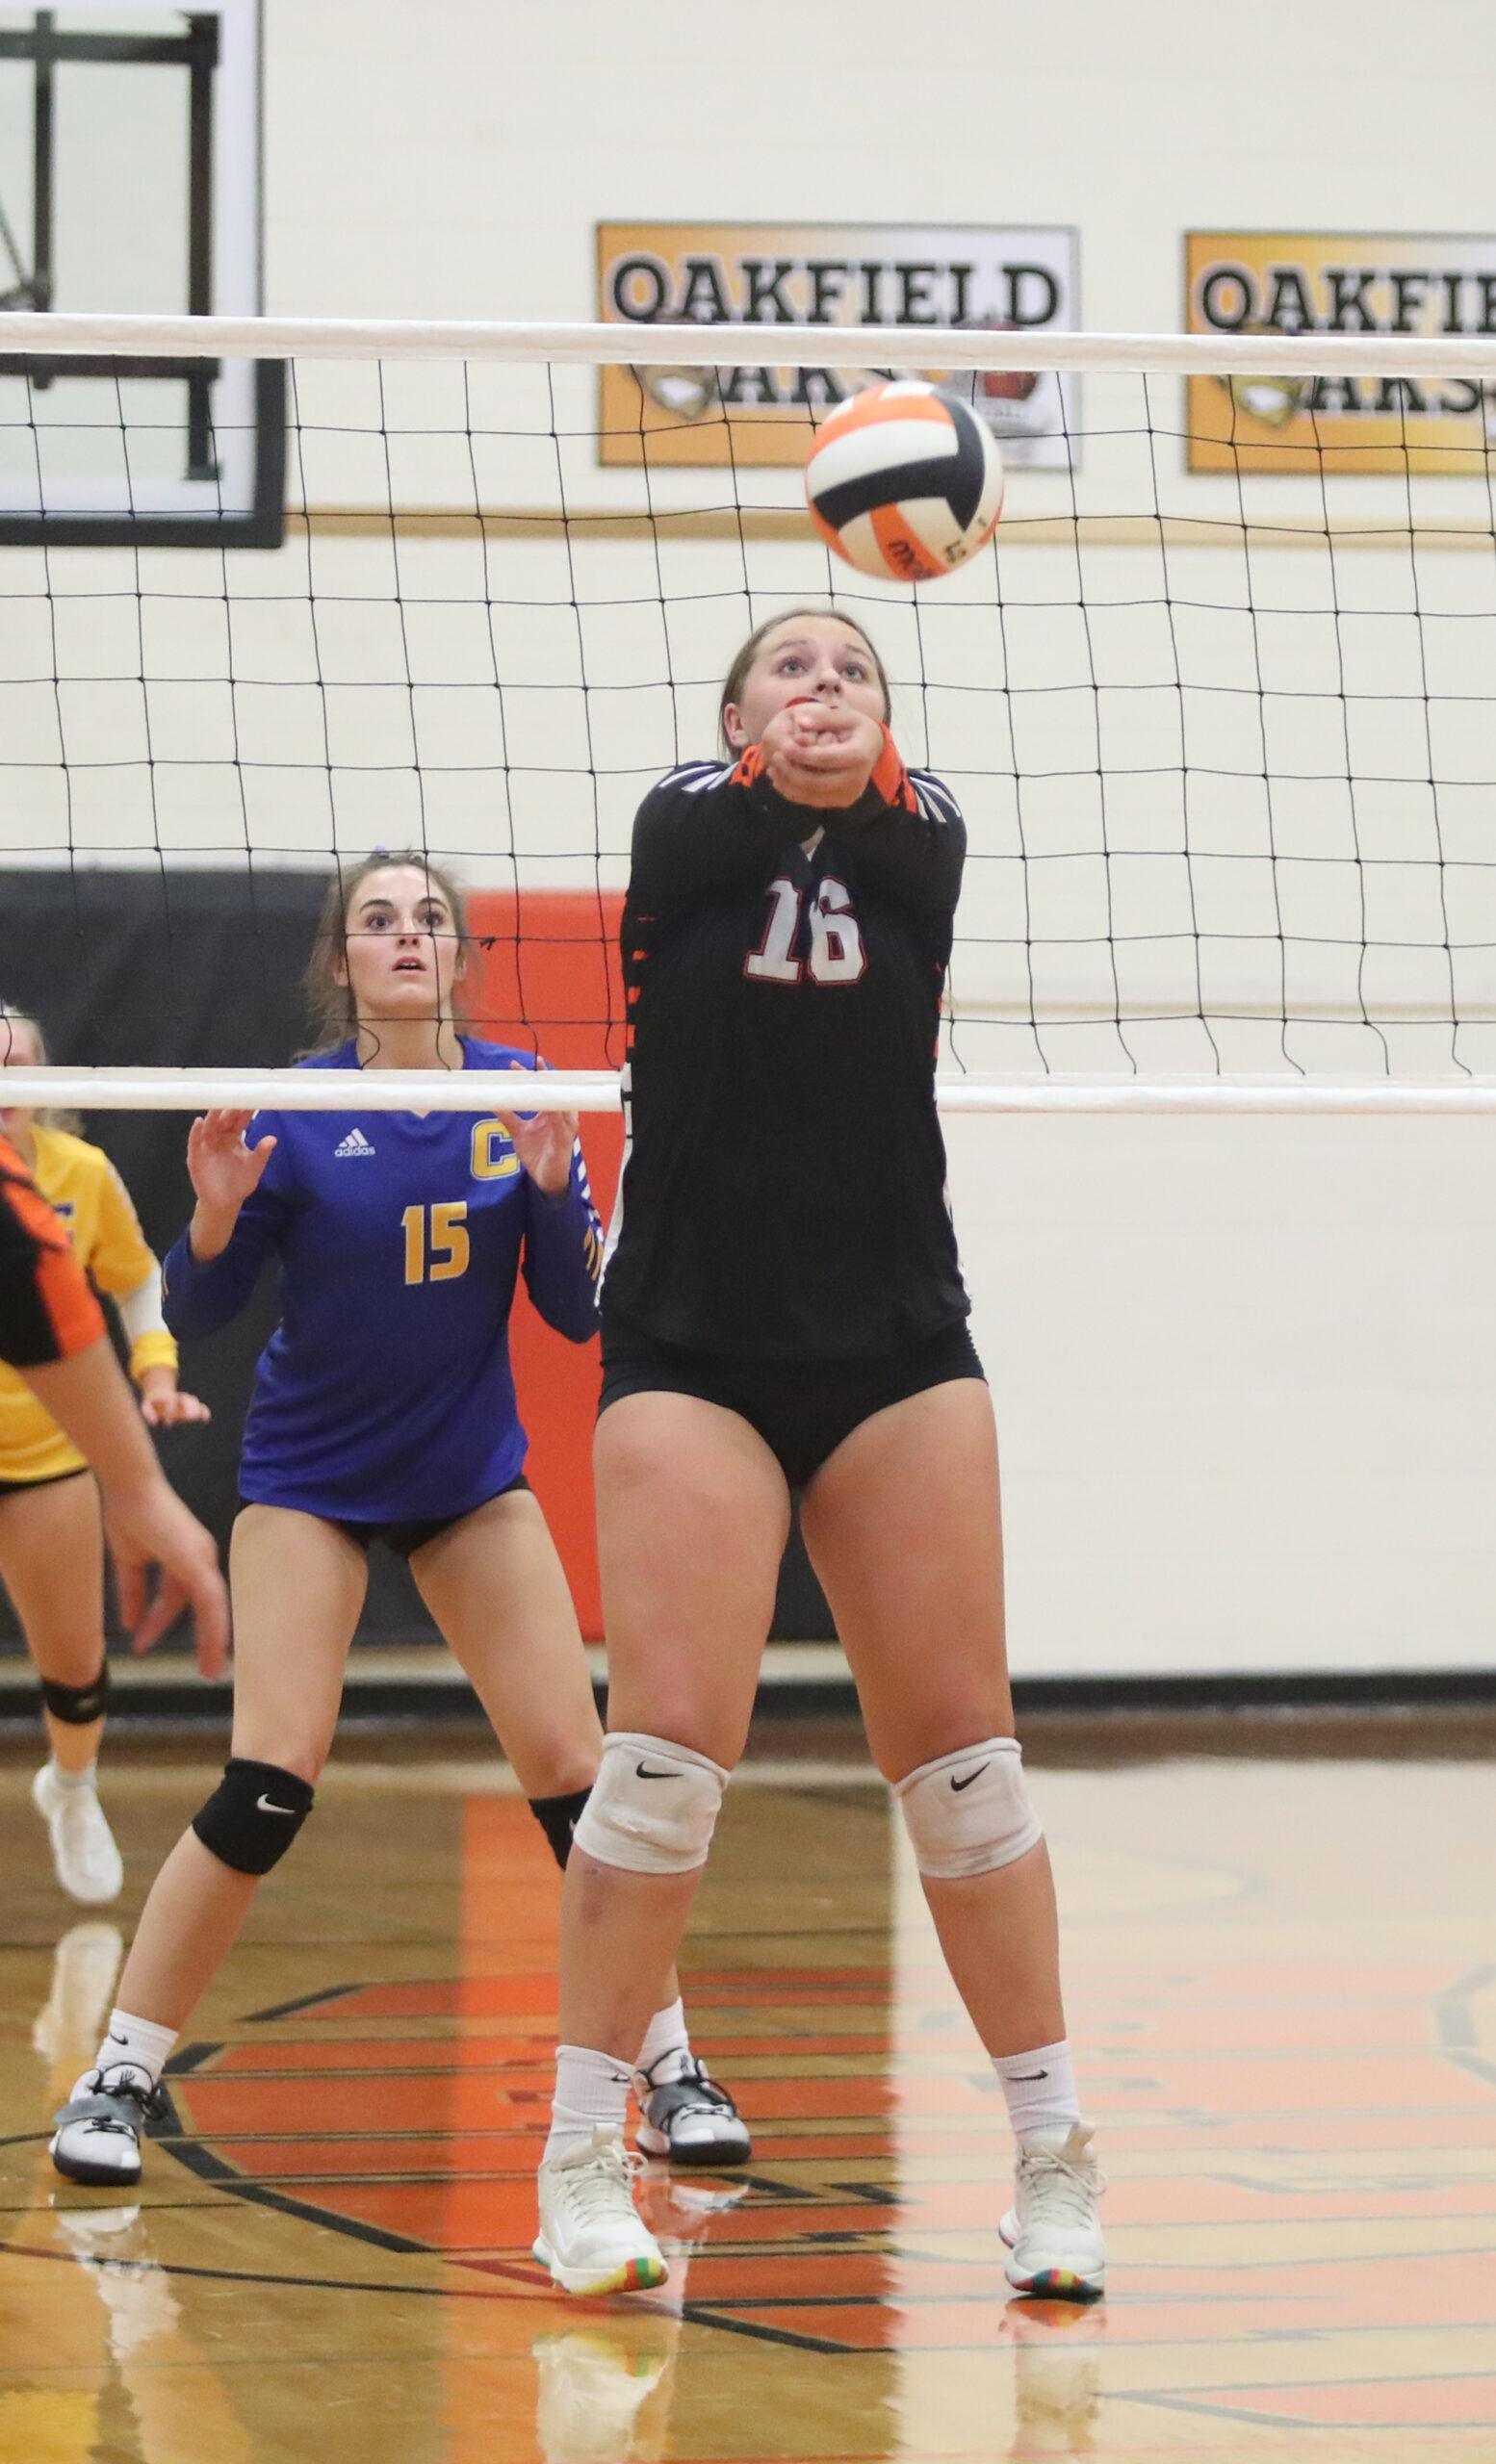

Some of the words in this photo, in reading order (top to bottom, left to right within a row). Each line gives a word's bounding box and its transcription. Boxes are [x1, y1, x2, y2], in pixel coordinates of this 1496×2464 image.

[612, 258, 1061, 326] OAKFIELD
[743, 874, 869, 987] 16
[334, 1145, 376, 1158] adidas
[470, 1117, 521, 1182] C
[400, 1199, 471, 1286] 15
